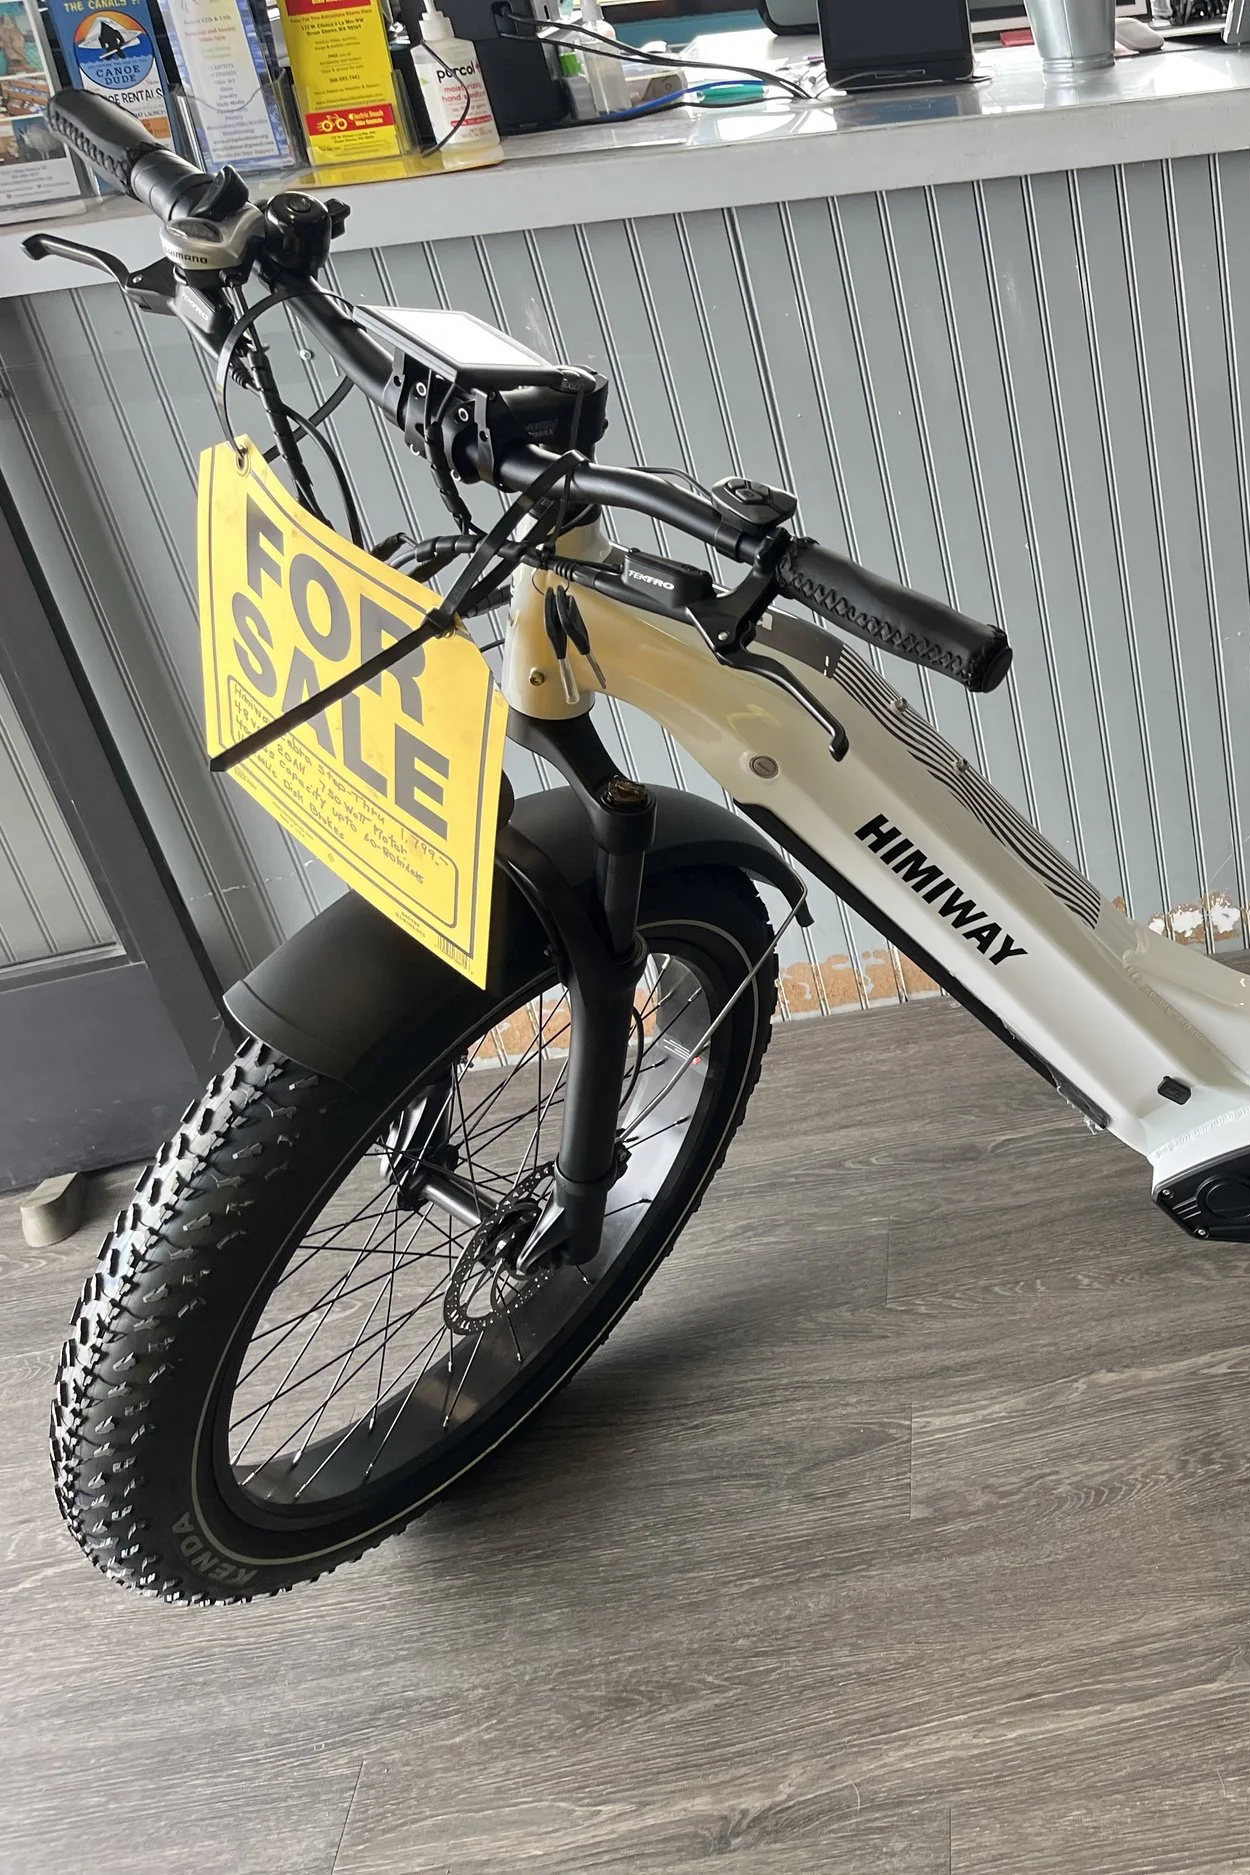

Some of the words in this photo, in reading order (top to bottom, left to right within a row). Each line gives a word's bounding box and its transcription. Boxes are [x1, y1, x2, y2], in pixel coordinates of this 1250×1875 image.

[96, 65, 140, 78] CANOE
[105, 75, 136, 85] DUDE
[628, 569, 675, 591] TEKTRO
[246, 492, 426, 727] FOR
[232, 591, 450, 841] SALE
[283, 779, 304, 804] Disk
[854, 813, 1029, 966] HIMIWAY
[171, 1511, 259, 1587] KENDA
